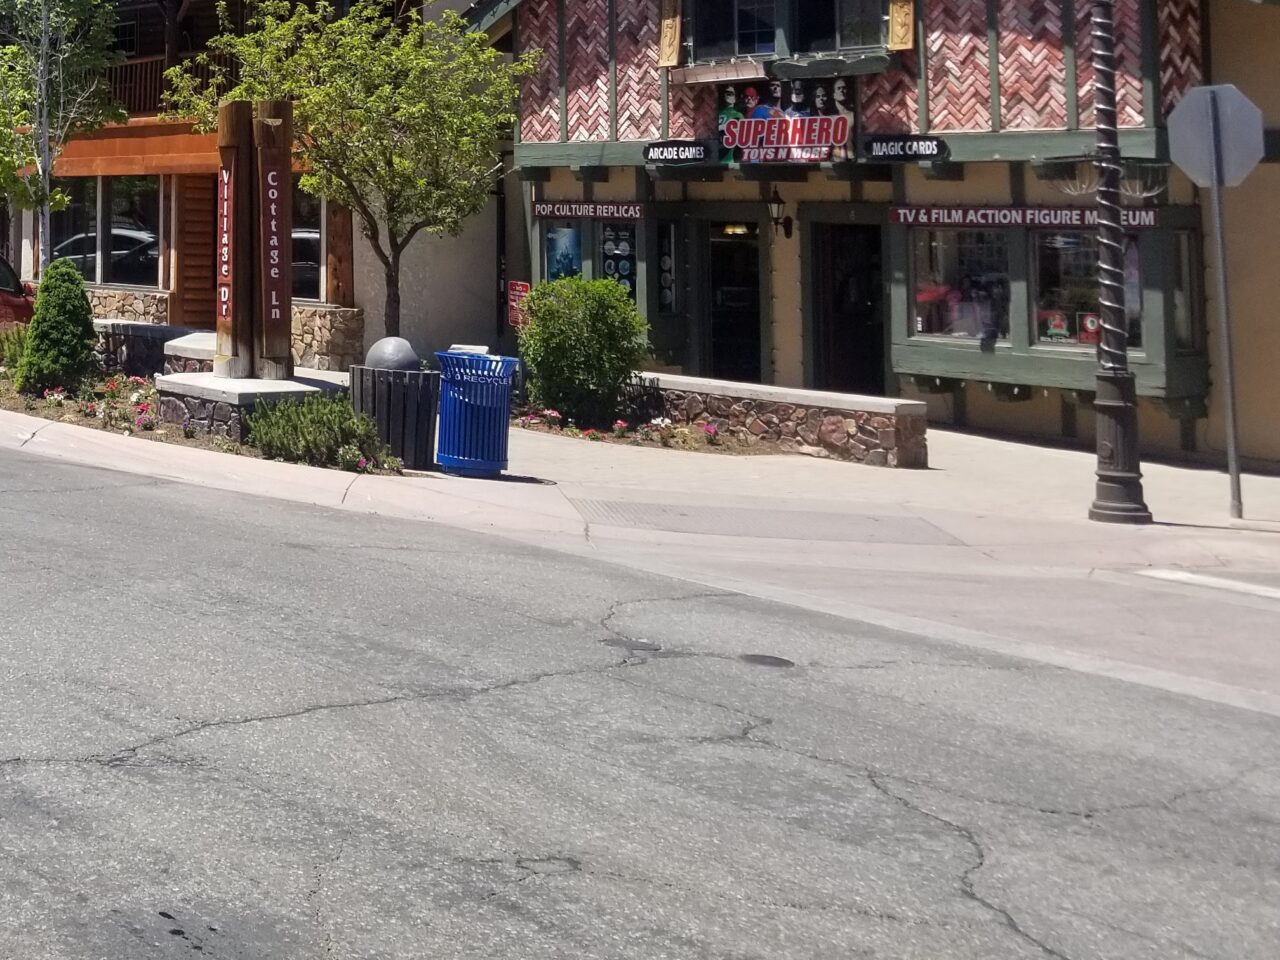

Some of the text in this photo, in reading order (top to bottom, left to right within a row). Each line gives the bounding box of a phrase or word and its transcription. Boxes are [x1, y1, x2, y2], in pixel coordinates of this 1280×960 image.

[723, 116, 848, 148] SUPERHERO
[648, 146, 704, 159] ARCADE GAMES
[742, 147, 829, 159] TOYS N MORE
[872, 141, 938, 155] MAGIC CARDS
[535, 204, 640, 218] POP CULTURE REPLICAS
[898, 209, 1155, 226] TV & FILM ACTION FIGURE MEUM
[221, 169, 230, 316] Village Dr
[267, 171, 281, 319] Cottage Ln
